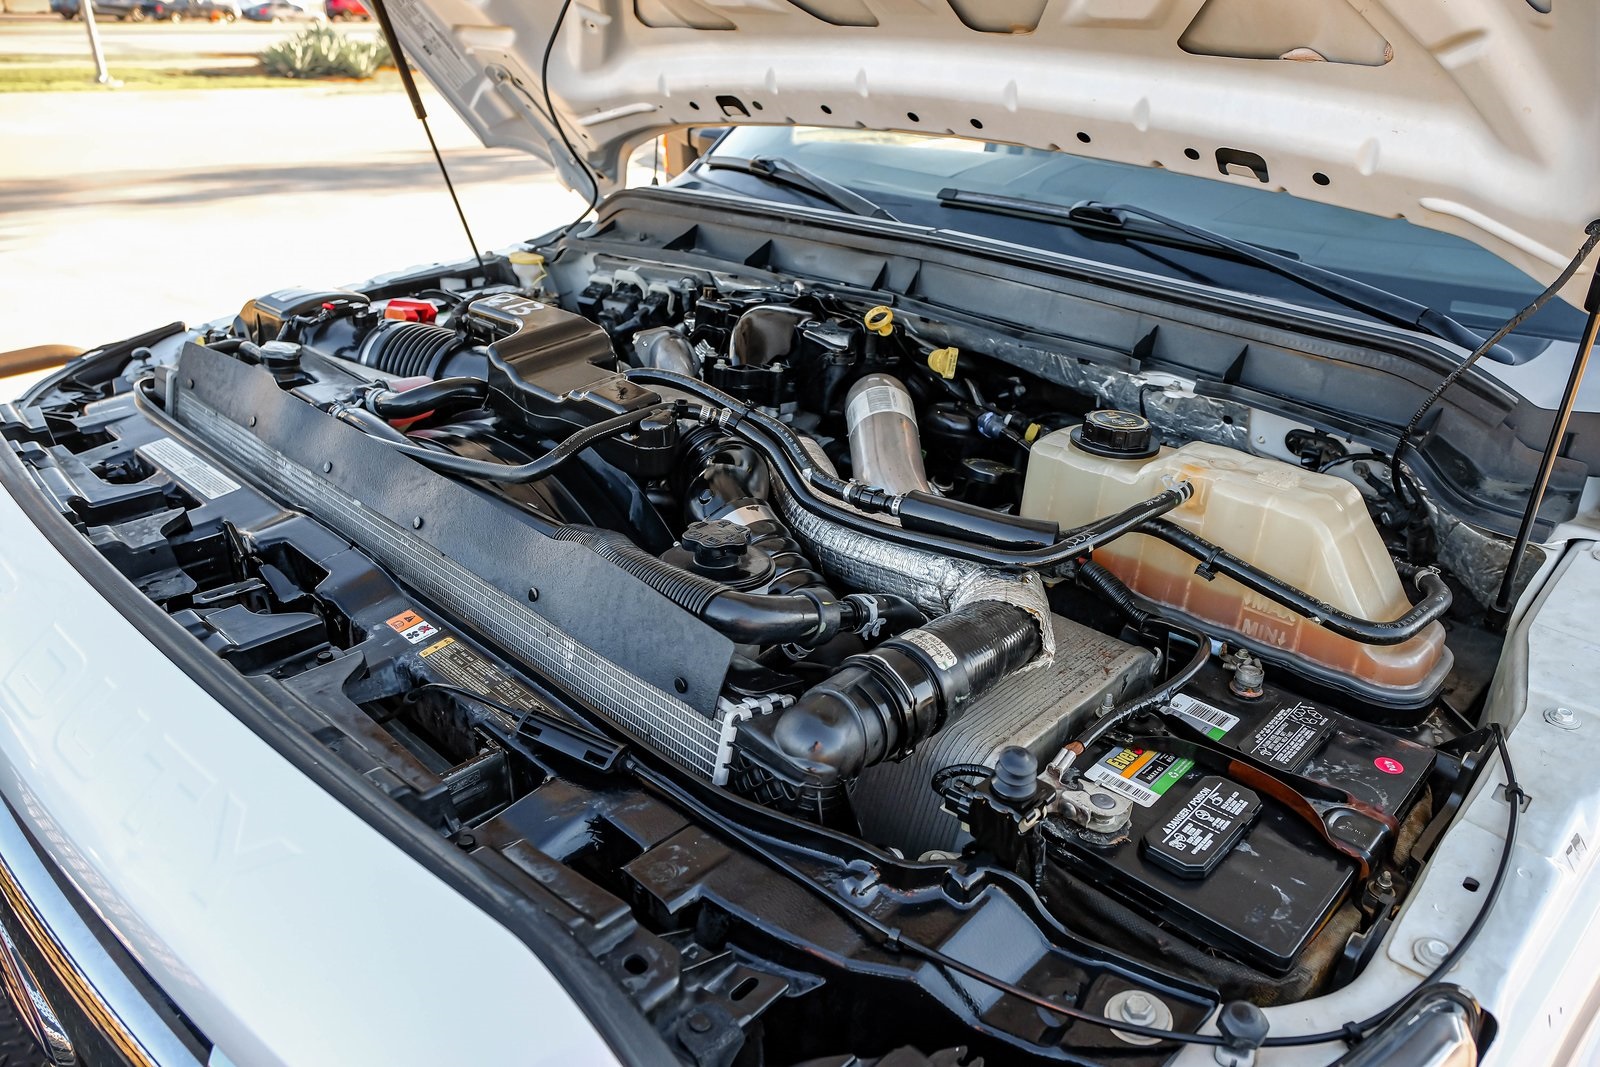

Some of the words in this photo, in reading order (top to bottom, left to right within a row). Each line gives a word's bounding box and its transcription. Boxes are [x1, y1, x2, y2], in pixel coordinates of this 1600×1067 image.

[1241, 618, 1278, 643] MIN
[1166, 807, 1191, 830] DANGER
[1189, 787, 1212, 807] POISON
